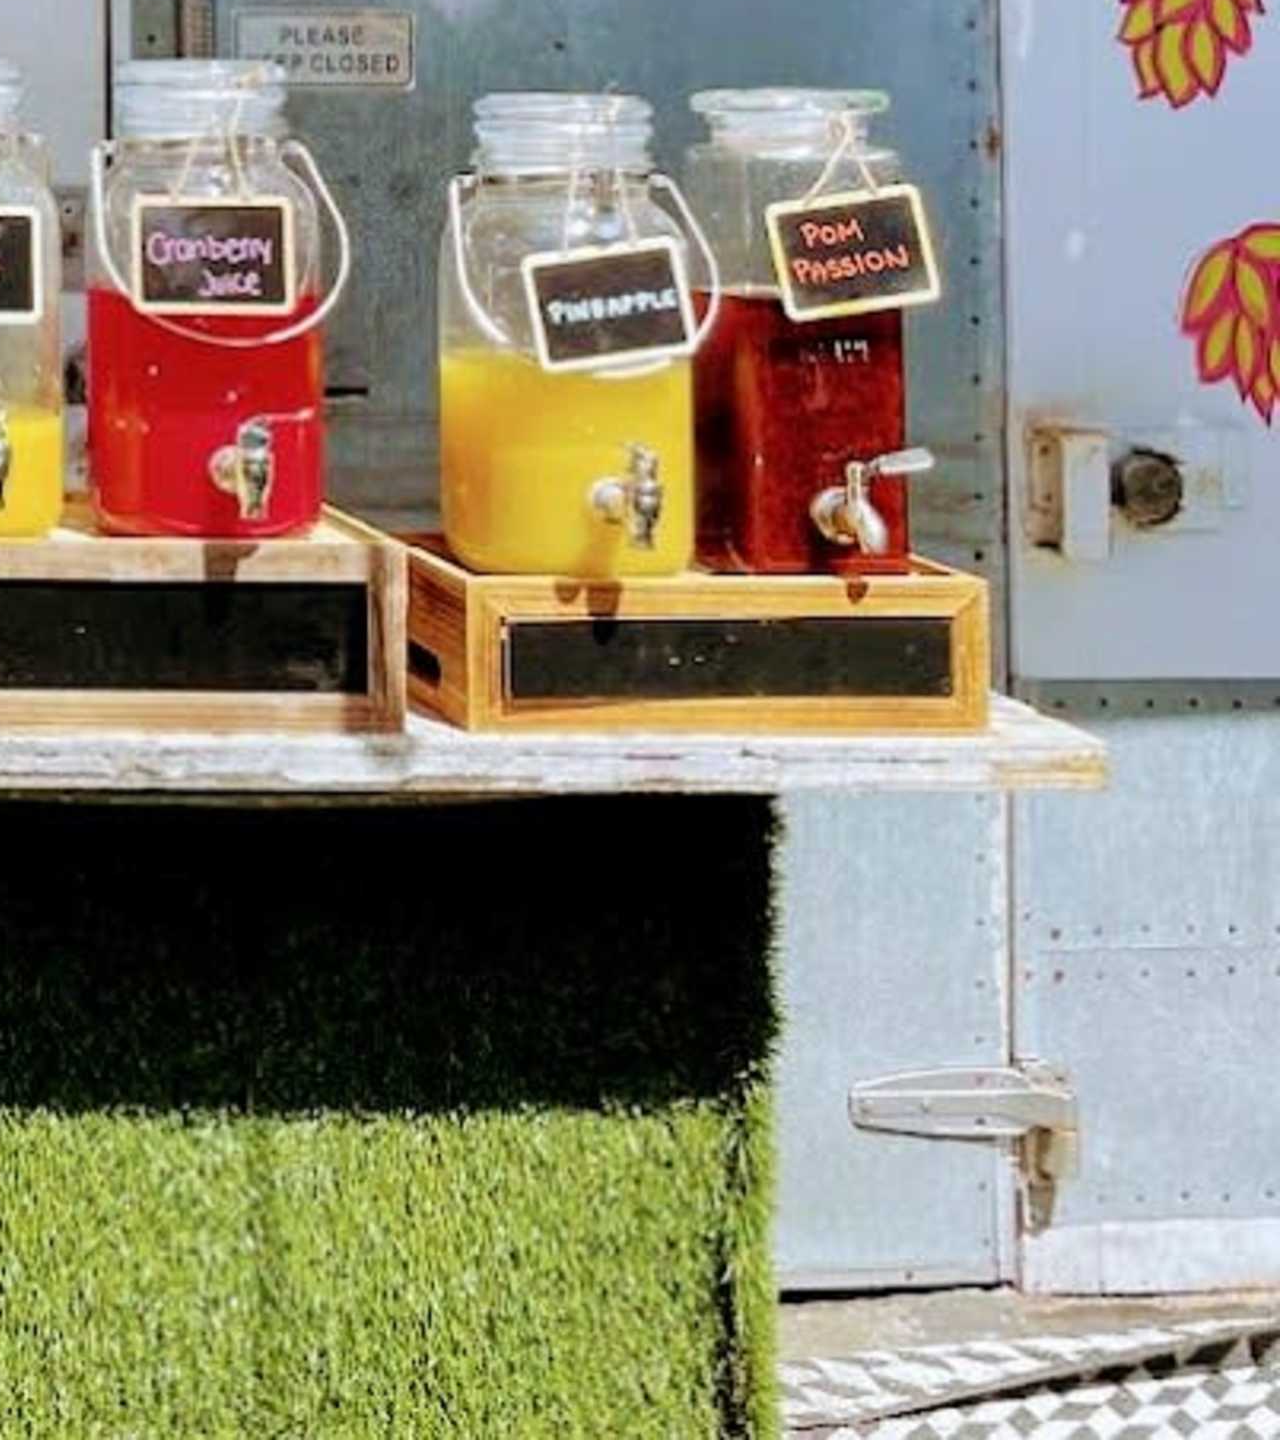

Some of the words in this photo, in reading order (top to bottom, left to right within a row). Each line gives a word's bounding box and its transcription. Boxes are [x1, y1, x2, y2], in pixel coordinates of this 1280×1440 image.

[279, 24, 365, 47] PLEASE
[310, 53, 401, 74] CLOSED
[800, 218, 865, 248] POM
[791, 245, 910, 284] PASSION
[545, 288, 679, 326] PINEAPPLE
